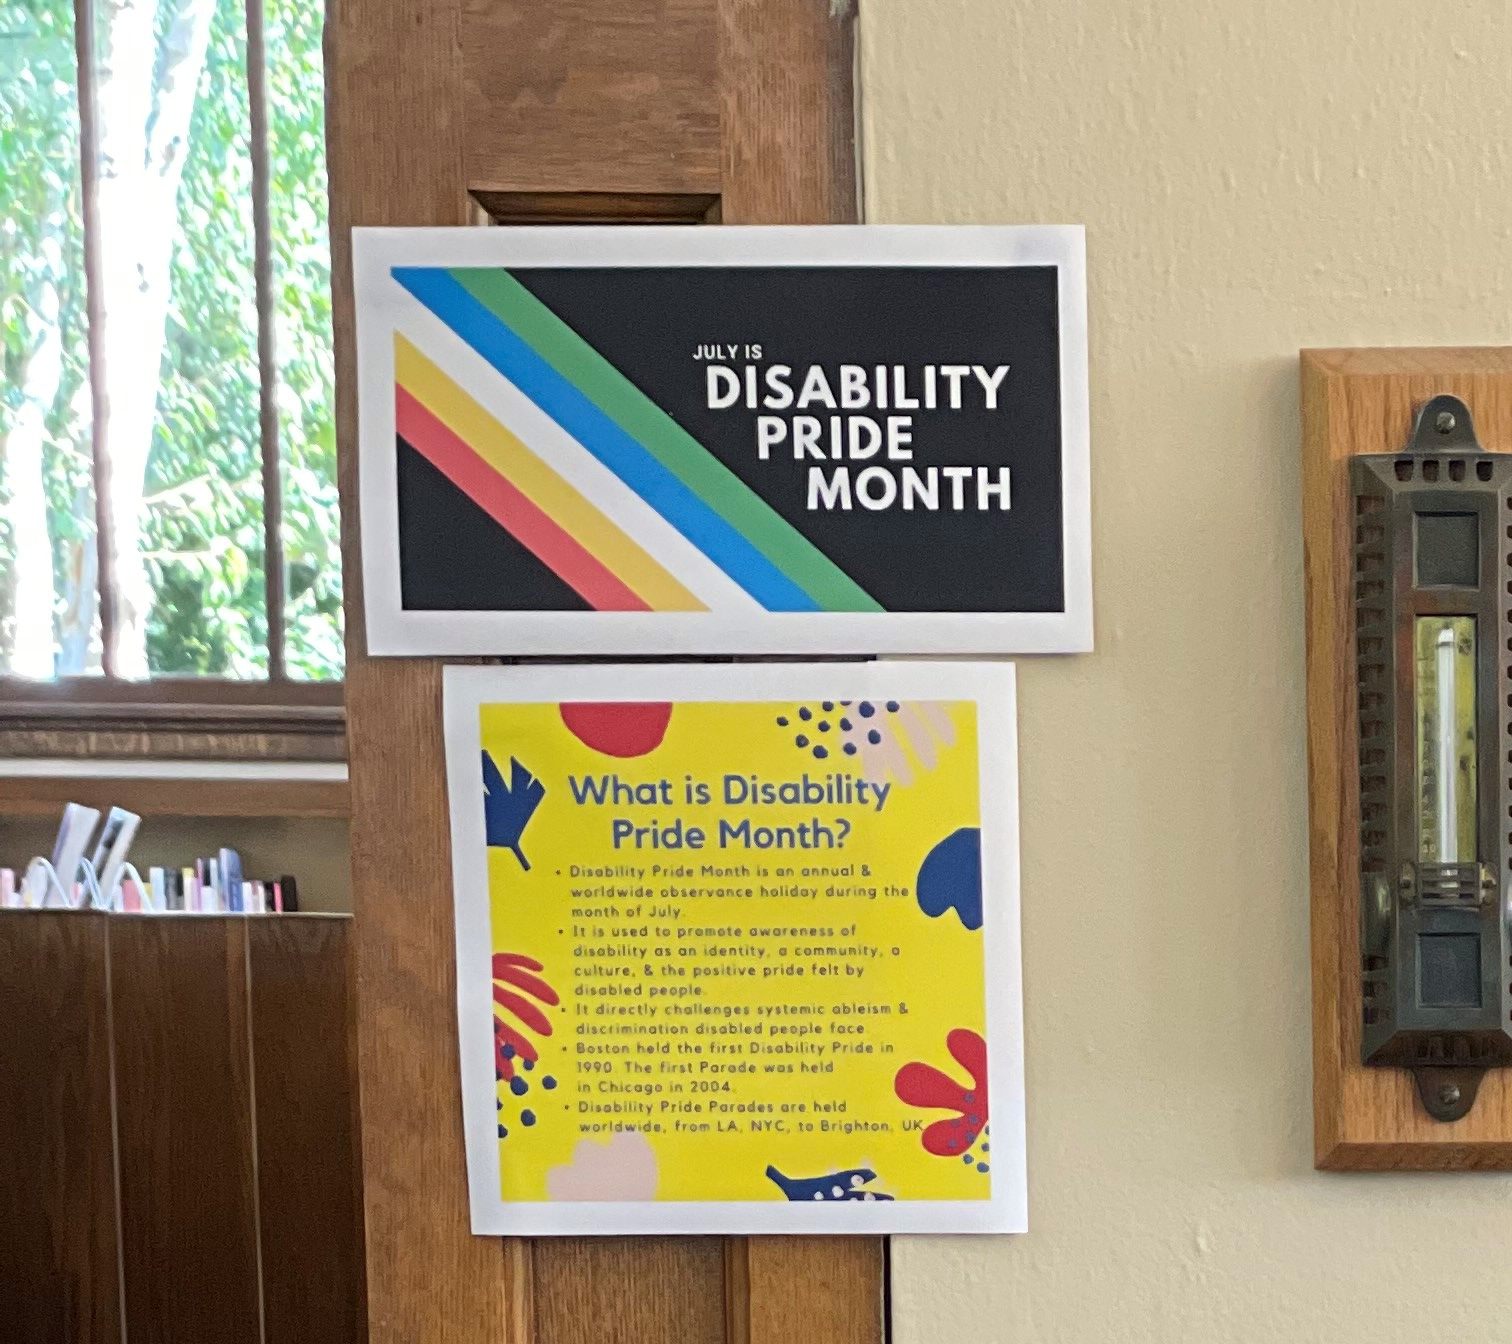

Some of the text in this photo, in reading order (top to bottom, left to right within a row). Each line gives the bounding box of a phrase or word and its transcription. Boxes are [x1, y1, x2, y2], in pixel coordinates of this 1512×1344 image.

[693, 345, 762, 360] JULY IS
[707, 365, 1010, 409] DISABILITY
[757, 416, 913, 460] PRIDE
[807, 467, 1011, 510] MONTH
[568, 773, 891, 811] What is Disability
[612, 818, 850, 849] Pride Month?
[570, 865, 872, 878] Disability Pride Month is an annual &
[571, 885, 910, 899] worldwide observance holiday during the
[572, 906, 620, 918] month
[626, 906, 641, 918] of
